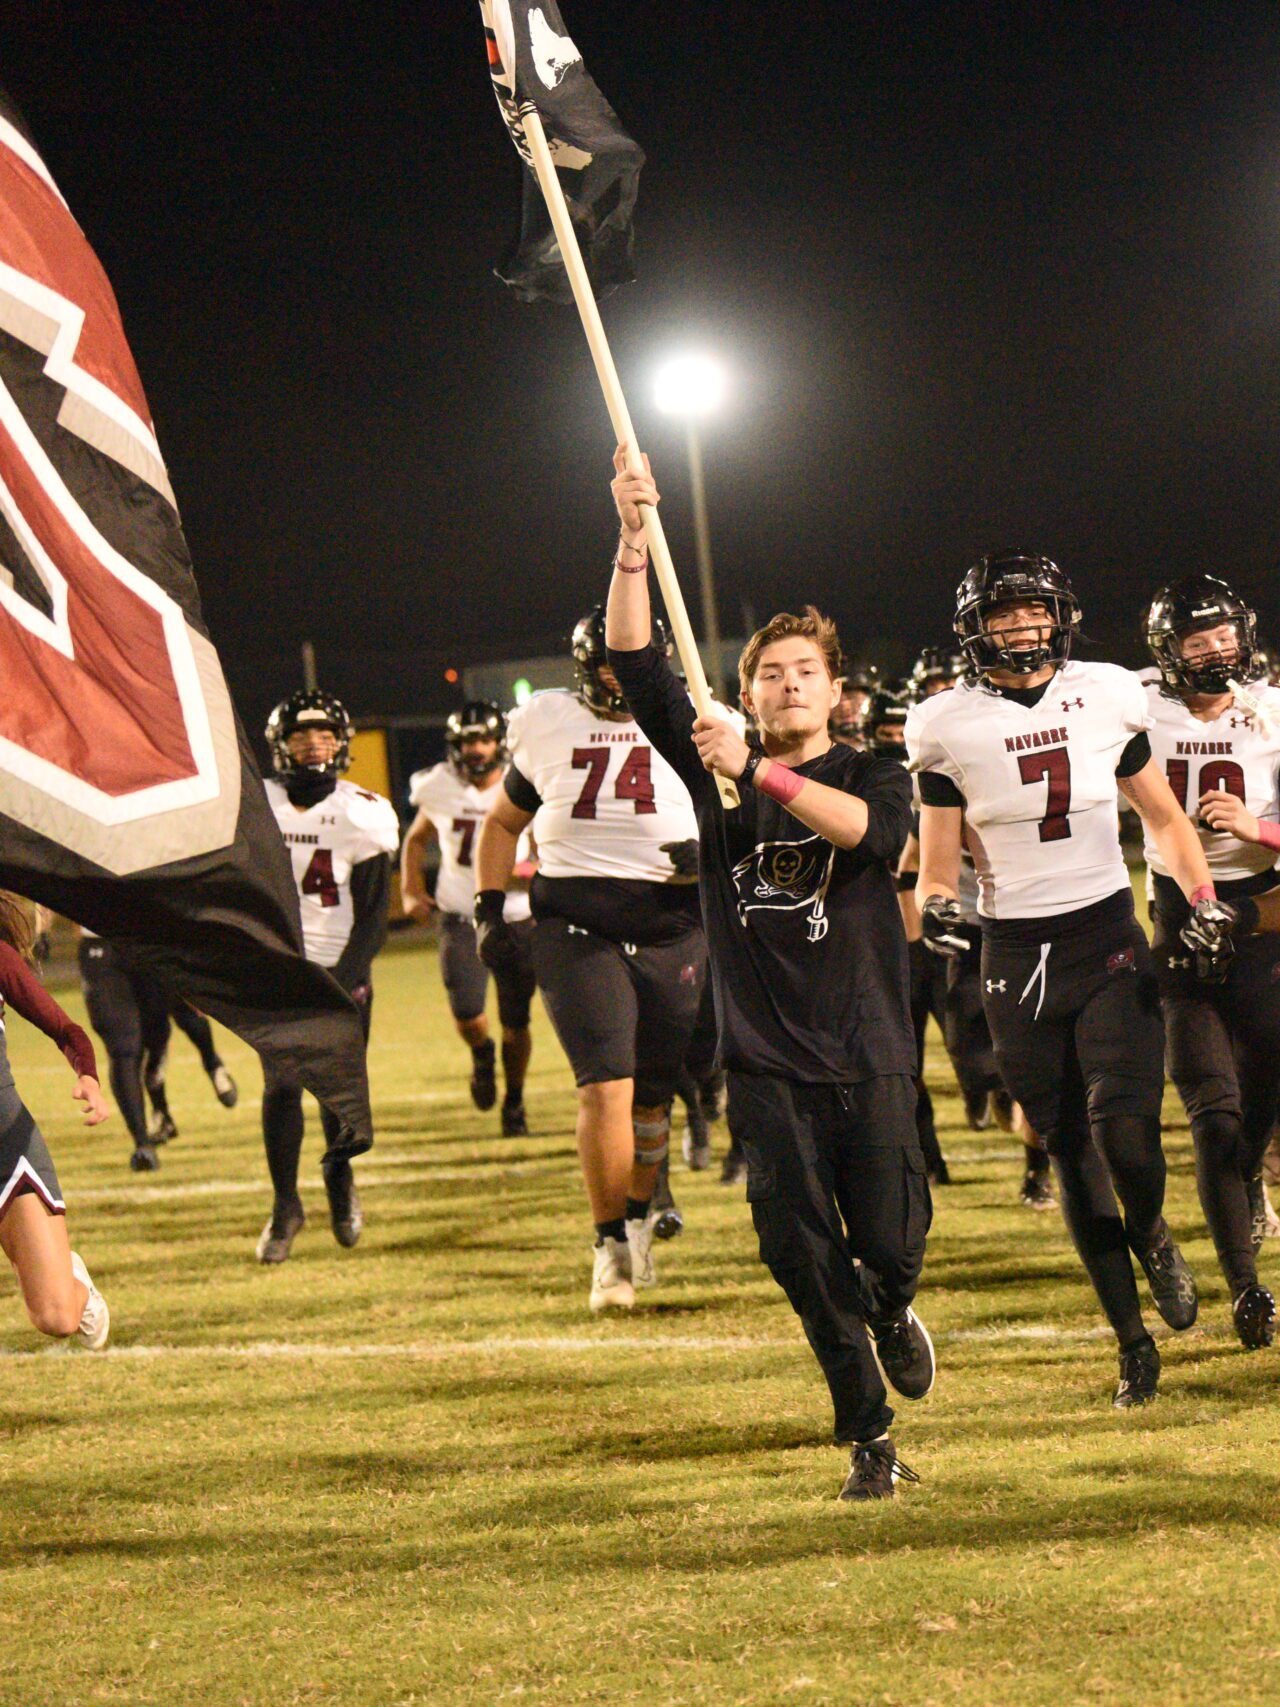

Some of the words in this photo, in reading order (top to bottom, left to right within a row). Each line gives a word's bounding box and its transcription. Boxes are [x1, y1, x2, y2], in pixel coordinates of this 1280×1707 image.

[1005, 727, 1069, 752] NAVARRE
[1176, 742, 1232, 754] NAVARRE
[571, 746, 657, 819] 74
[1017, 746, 1072, 843] 7
